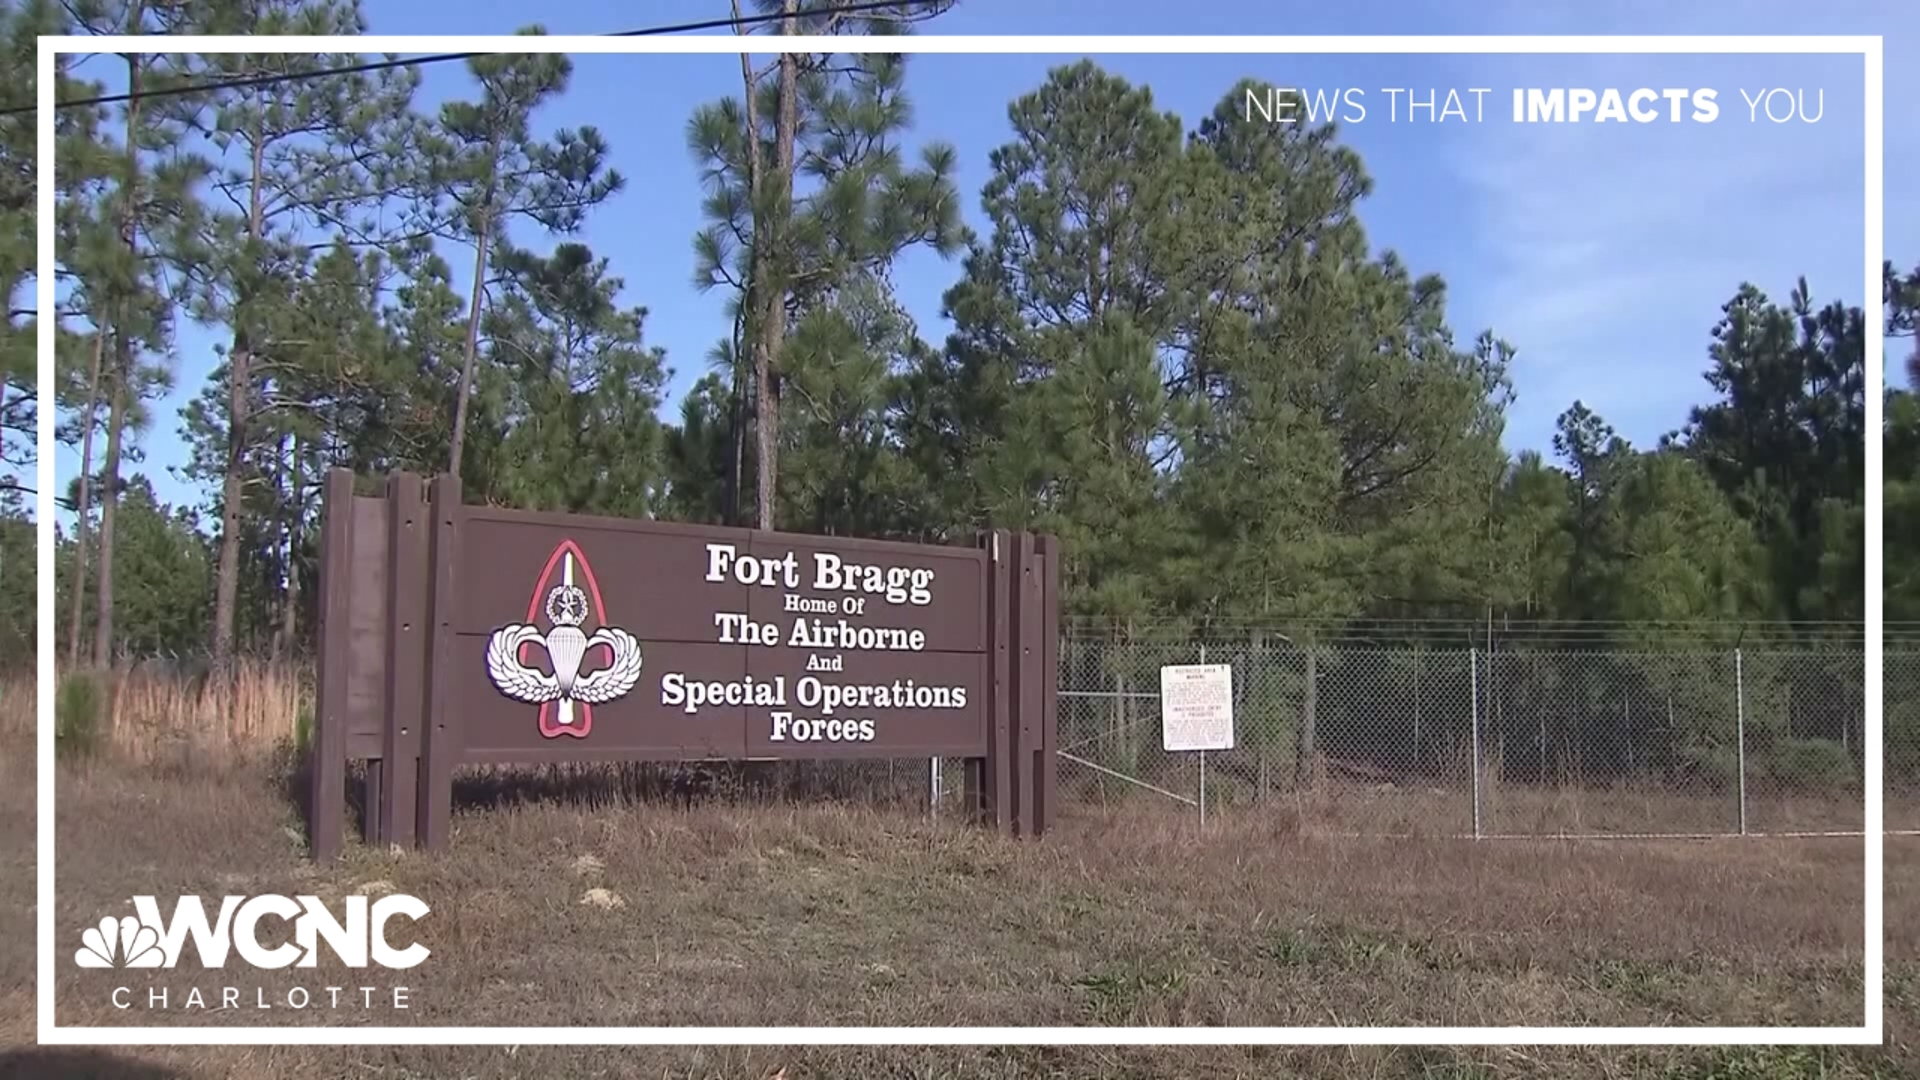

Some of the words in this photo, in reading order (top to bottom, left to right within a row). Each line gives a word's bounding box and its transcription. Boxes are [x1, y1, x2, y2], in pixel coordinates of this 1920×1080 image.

[706, 544, 800, 588] Fort
[813, 552, 935, 605] Bragg
[784, 594, 837, 614] Home
[842, 596, 866, 615] Of
[716, 614, 779, 646] The
[788, 618, 925, 651] Airborne
[806, 654, 843, 671] And
[661, 674, 786, 713] Special
[796, 676, 967, 715] Operations
[770, 713, 875, 741] Forces
